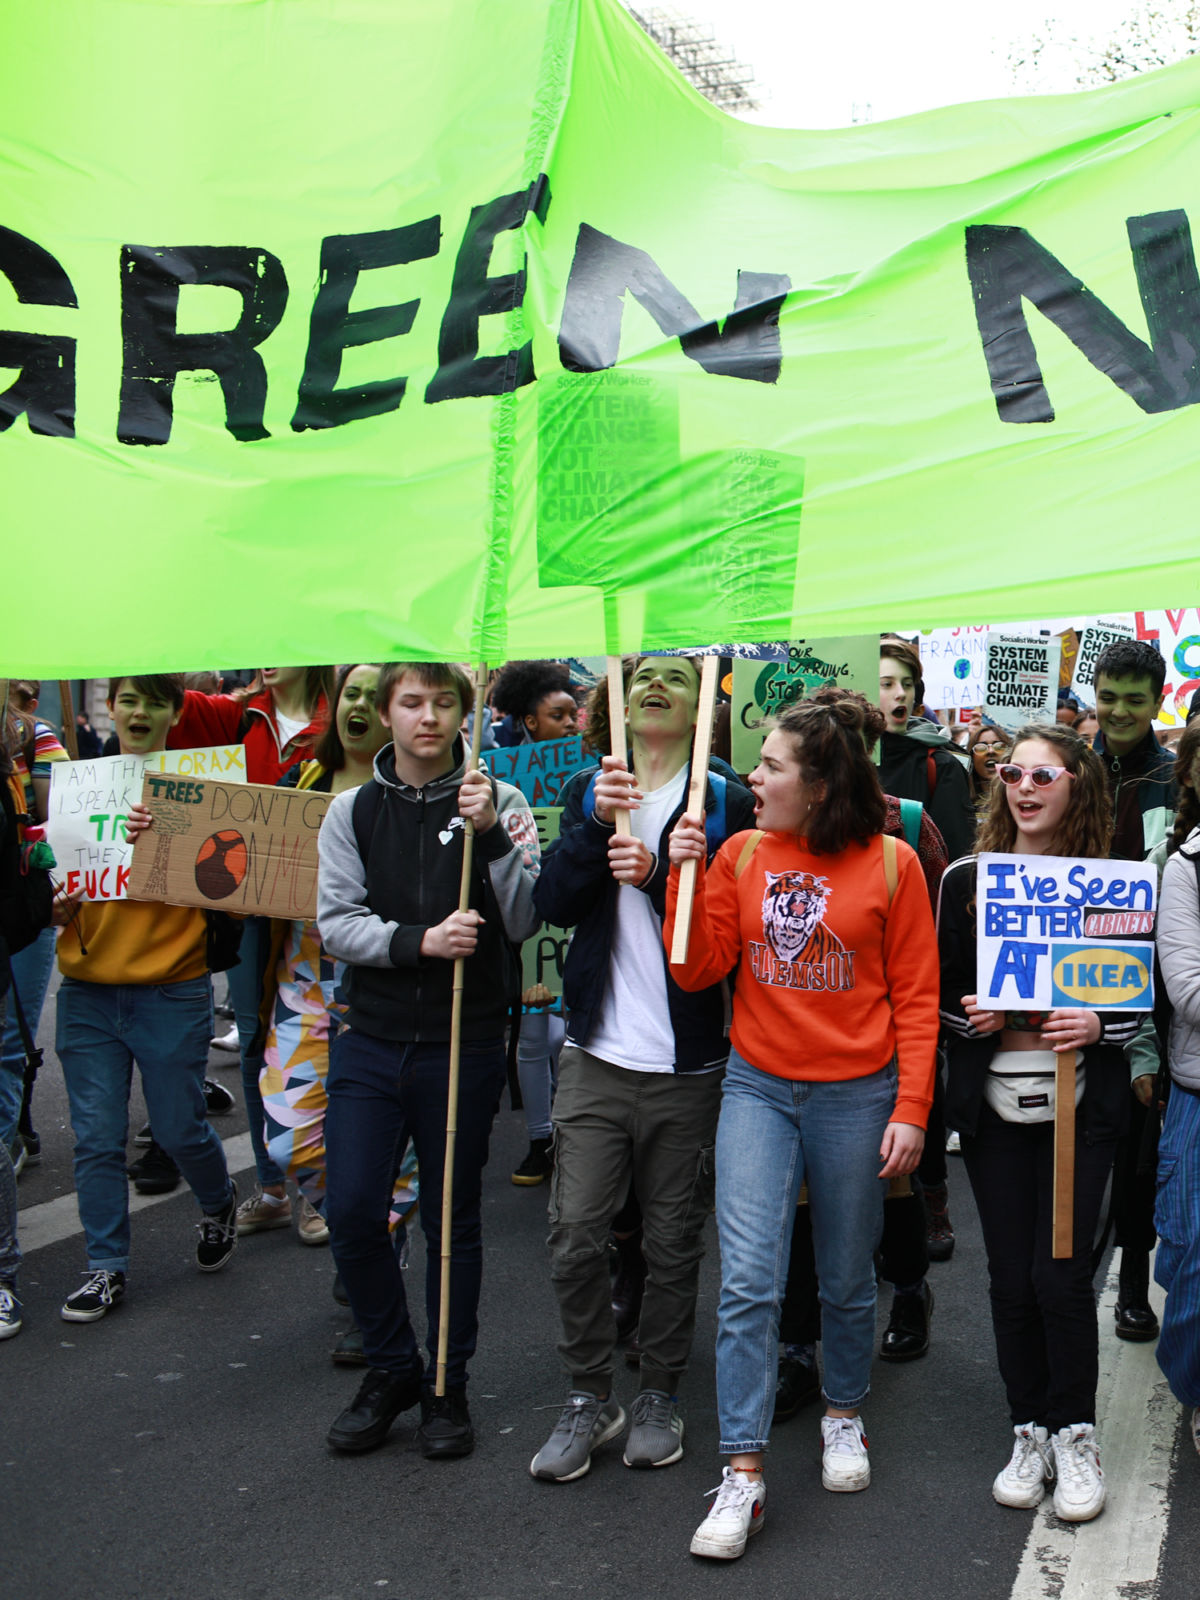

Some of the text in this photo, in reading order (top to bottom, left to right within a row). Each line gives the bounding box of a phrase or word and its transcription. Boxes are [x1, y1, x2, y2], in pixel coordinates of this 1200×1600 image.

[542, 420, 657, 447] CHANGE
[542, 470, 650, 497] CLIMAT
[789, 647, 813, 658] OUR
[989, 646, 1047, 660] SYSTEM
[1000, 635, 1048, 645] Socialist Worker
[988, 658, 1049, 673] CHANGE
[1081, 651, 1100, 663] NO
[988, 670, 1017, 682] NOT
[943, 685, 985, 706] PLAN
[986, 694, 1047, 709] CHANGE
[987, 682, 1049, 697] CLIMATE
[68, 764, 97, 786] AM
[110, 759, 153, 783] THE
[160, 747, 245, 776] LORAX
[490, 741, 598, 778] LY AFTER
[71, 788, 134, 814] SPEAK
[148, 778, 205, 804] TREES
[211, 787, 298, 827] DON'T
[74, 848, 129, 867] THEY
[270, 833, 320, 911] MO
[986, 864, 1153, 911] I've Seen
[985, 901, 1156, 939] BETTER CABINETS
[748, 941, 857, 992] CLEMSON
[989, 940, 1143, 999] AT IKEA
